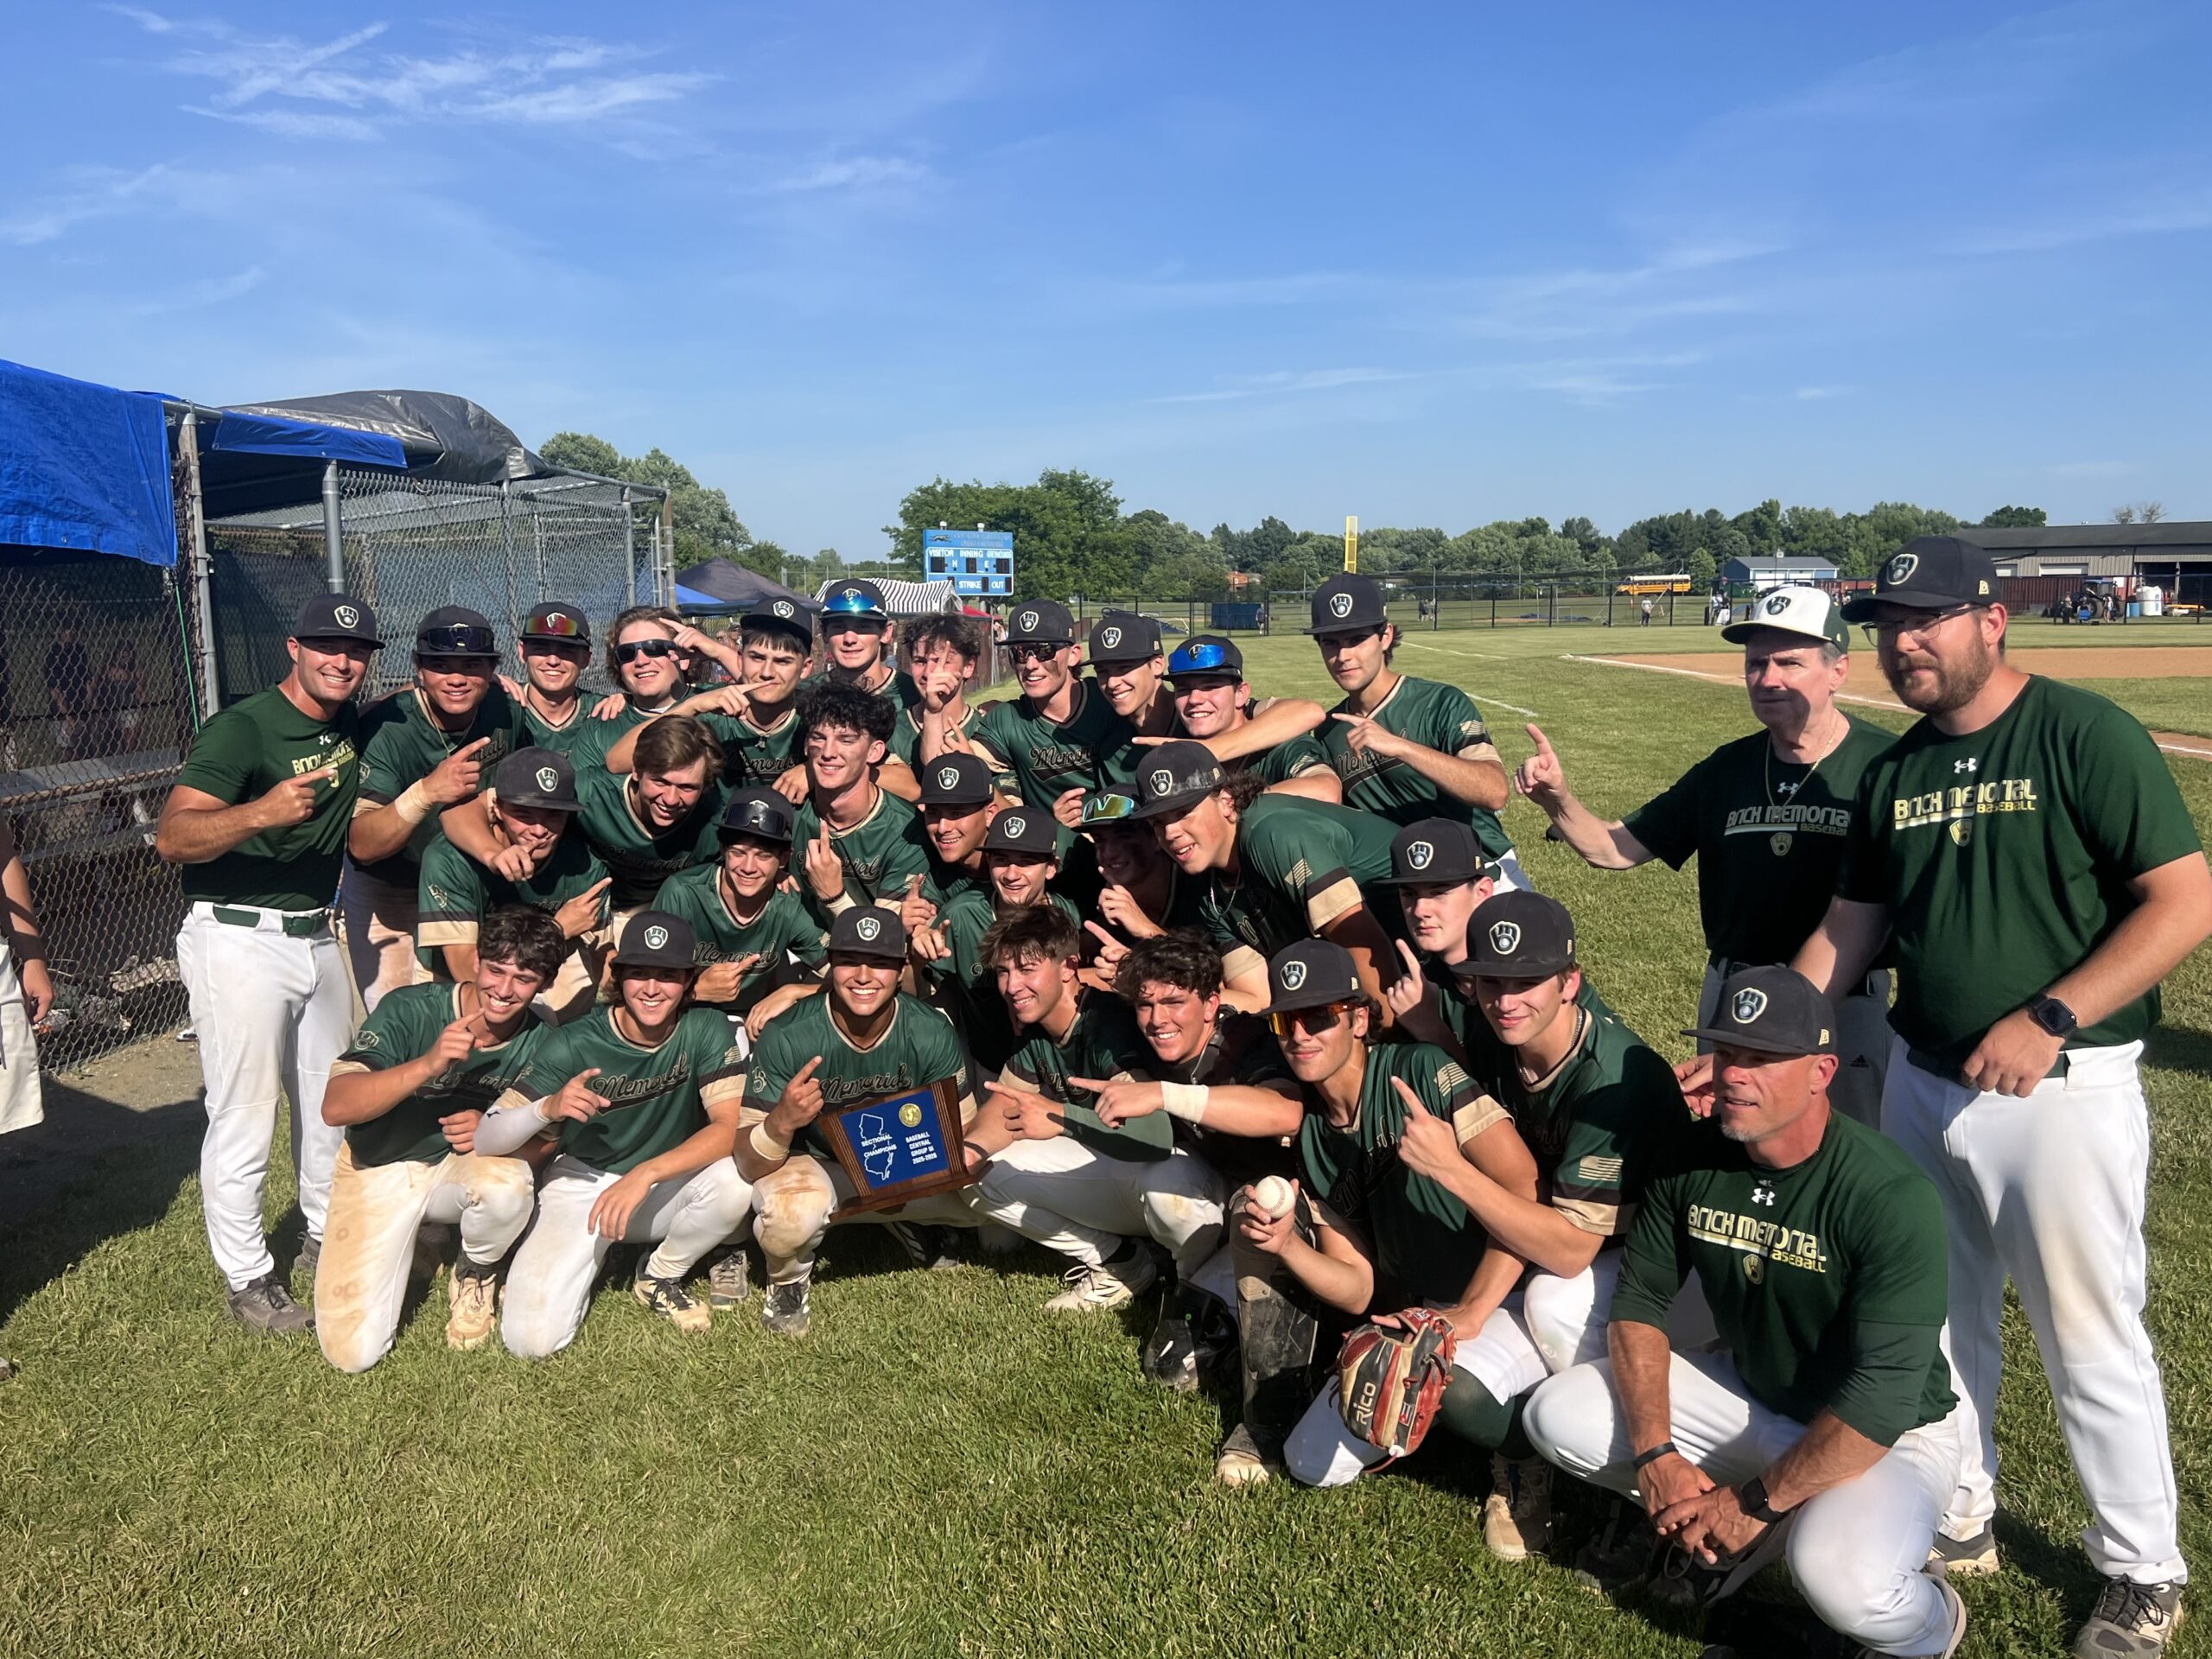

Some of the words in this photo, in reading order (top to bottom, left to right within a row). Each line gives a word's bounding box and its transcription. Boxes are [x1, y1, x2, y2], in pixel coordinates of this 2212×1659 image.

[929, 549, 954, 557] VISITOR
[959, 550, 983, 558] INNING
[952, 559, 957, 568] H
[958, 580, 982, 589] STRIKE
[991, 581, 1005, 589] OUT
[861, 1134, 893, 1147] SECTIONAL
[906, 1131, 931, 1143] BASEBALL
[909, 1139, 931, 1150] CENTRAL
[864, 1144, 897, 1158] CHAMPIONS
[911, 1147, 928, 1157] GROUP
[1688, 1204, 1736, 1236] BRICK
[1352, 1382, 1376, 1426] Rico
